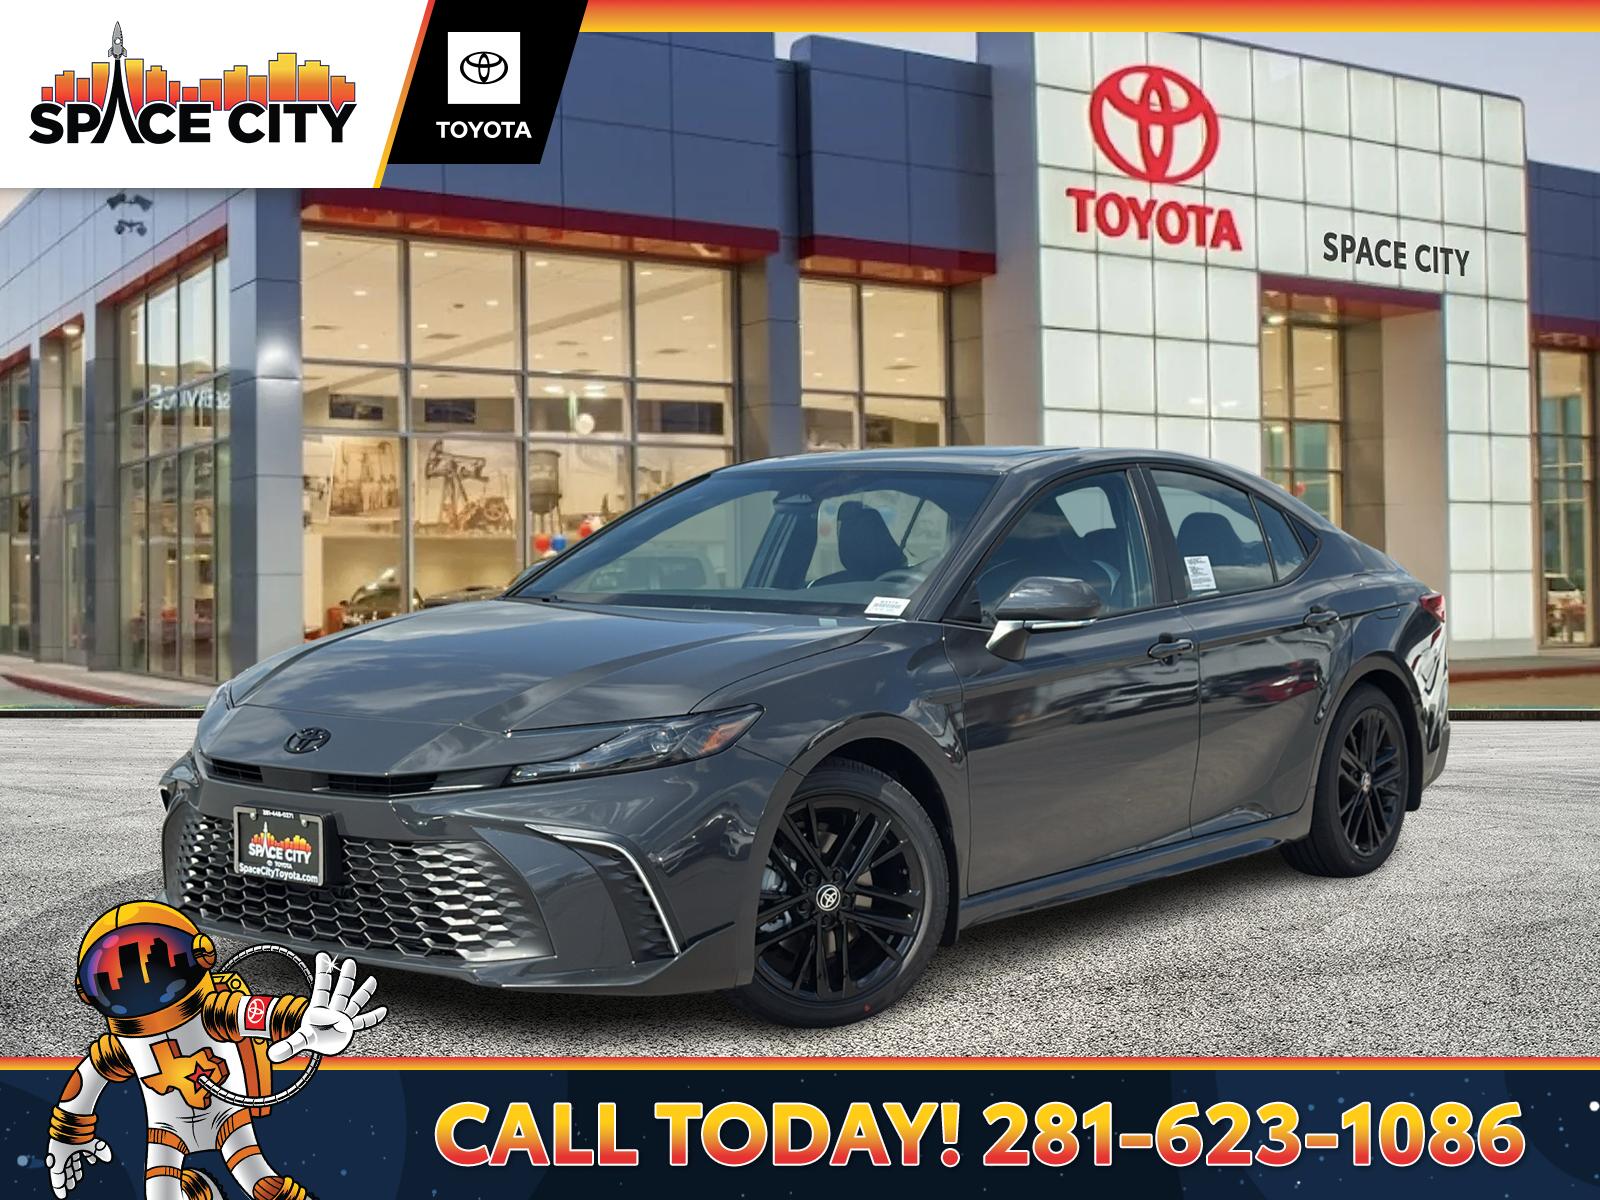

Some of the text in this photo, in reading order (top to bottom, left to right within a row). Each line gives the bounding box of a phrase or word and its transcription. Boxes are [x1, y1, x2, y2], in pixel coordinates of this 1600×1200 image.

[1065, 187, 1243, 252] TOYOTA
[1322, 231, 1471, 278] SPACE CITY
[248, 838, 312, 864] SPACE CITY
[239, 863, 319, 884] SpaceCityToyota.com
[274, 861, 293, 870] TOYOTA
